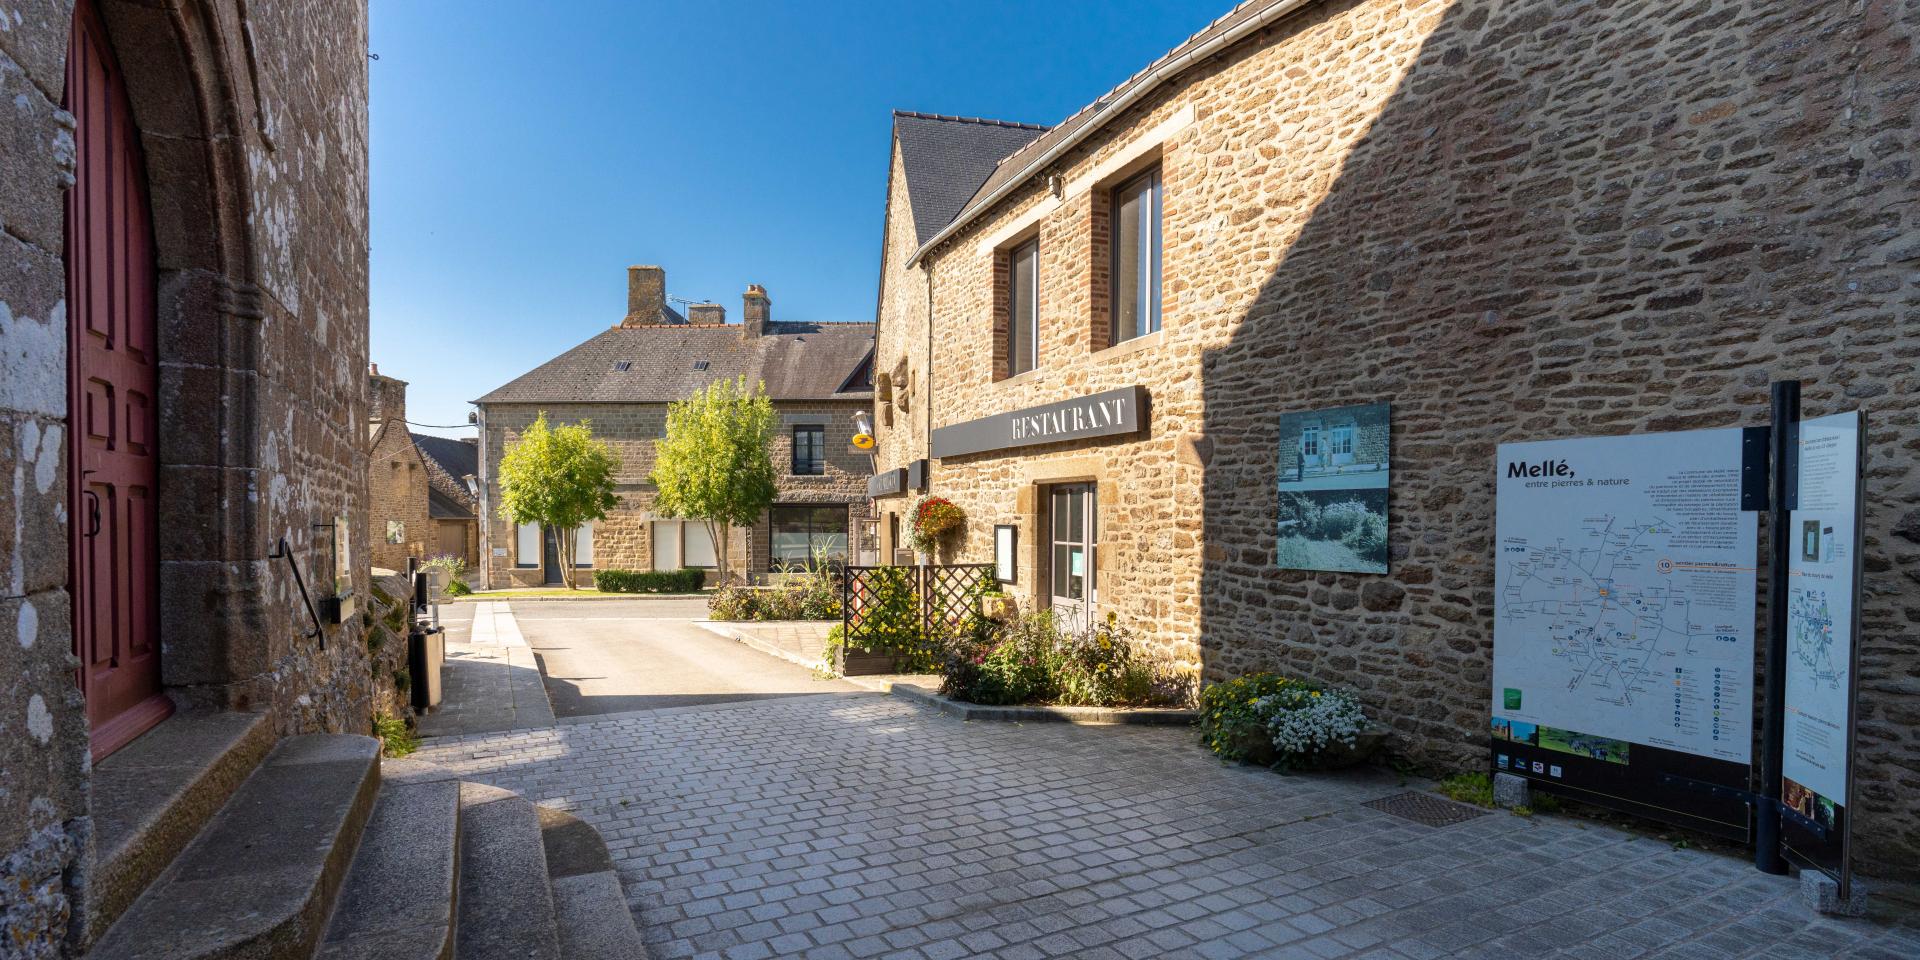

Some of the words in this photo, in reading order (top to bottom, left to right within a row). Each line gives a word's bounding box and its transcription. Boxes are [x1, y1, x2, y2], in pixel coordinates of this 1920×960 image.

[1012, 398, 1126, 440] RESTAURANT
[1507, 459, 1575, 479] Mellé,
[1525, 479, 1549, 488] entre
[1551, 479, 1584, 489] pierres
[1586, 478, 1594, 486] &
[1597, 478, 1630, 486] nature
